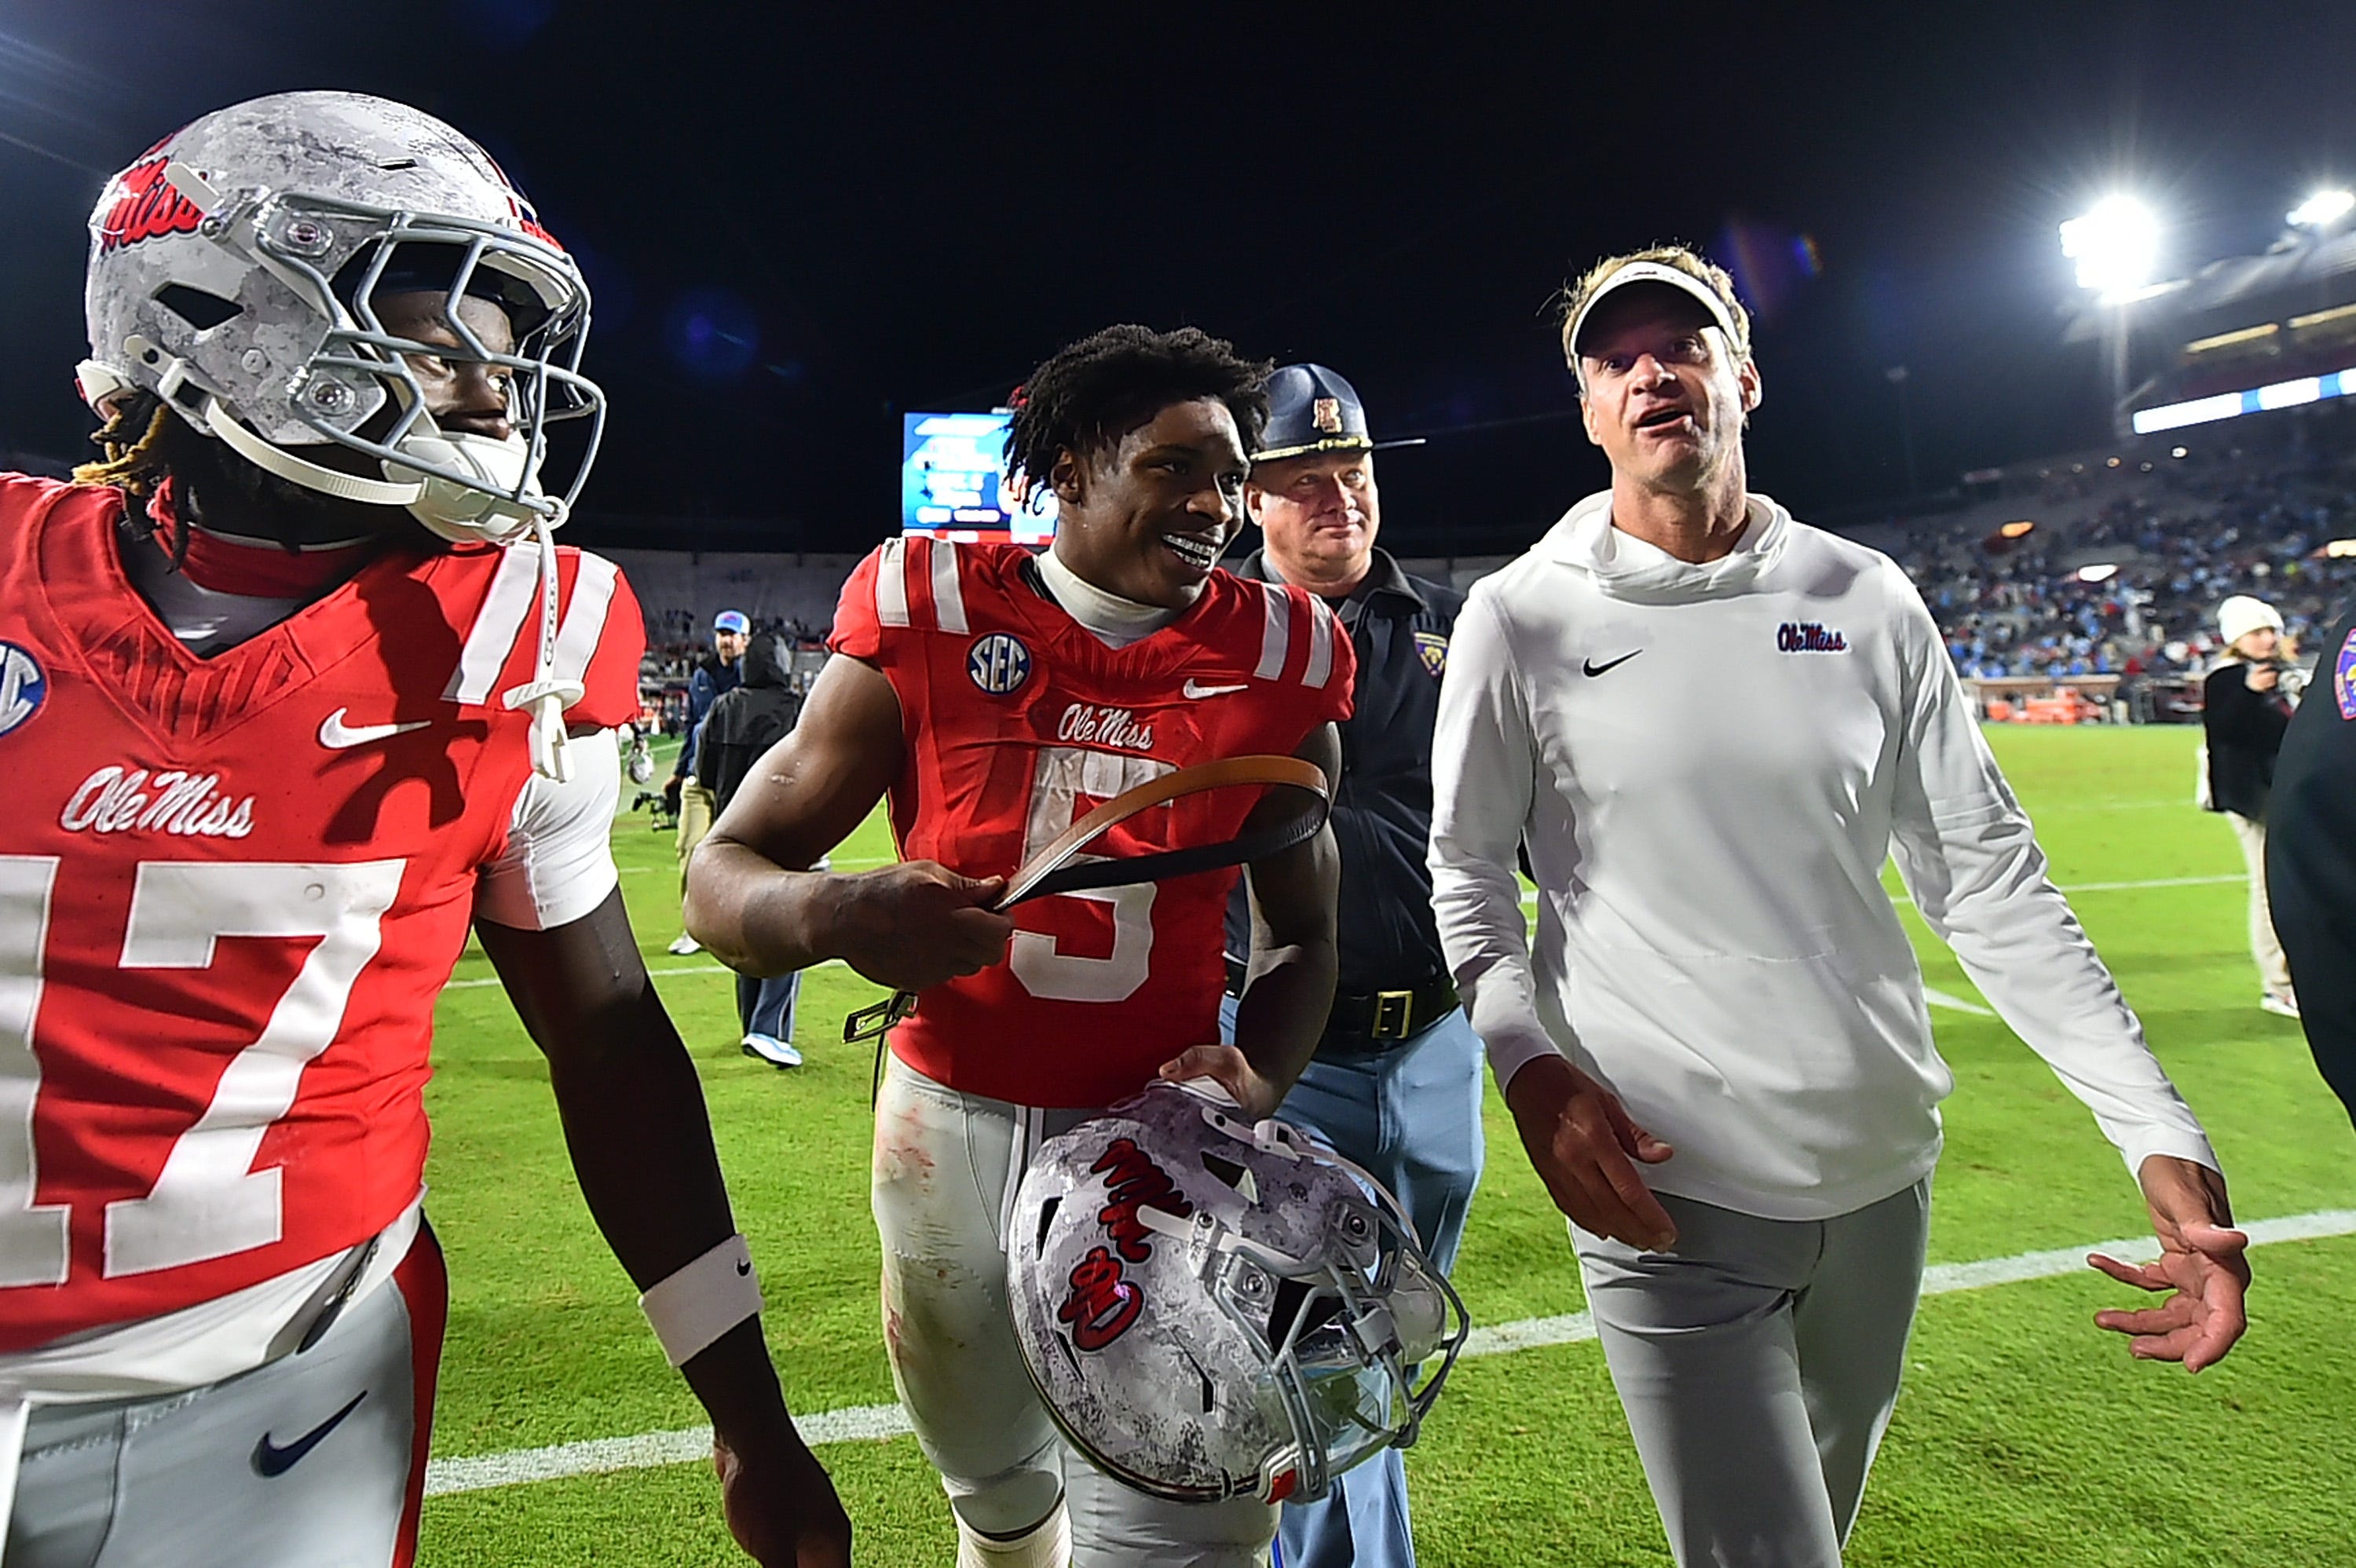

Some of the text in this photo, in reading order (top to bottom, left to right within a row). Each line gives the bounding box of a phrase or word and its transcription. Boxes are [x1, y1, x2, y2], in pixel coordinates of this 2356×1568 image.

[971, 634, 1026, 692] SEC
[1777, 623, 1848, 652] Ole Miss
[1058, 704, 1154, 750] Ole Miss
[61, 766, 255, 838] Ole Miss
[1010, 747, 1178, 1002] 5
